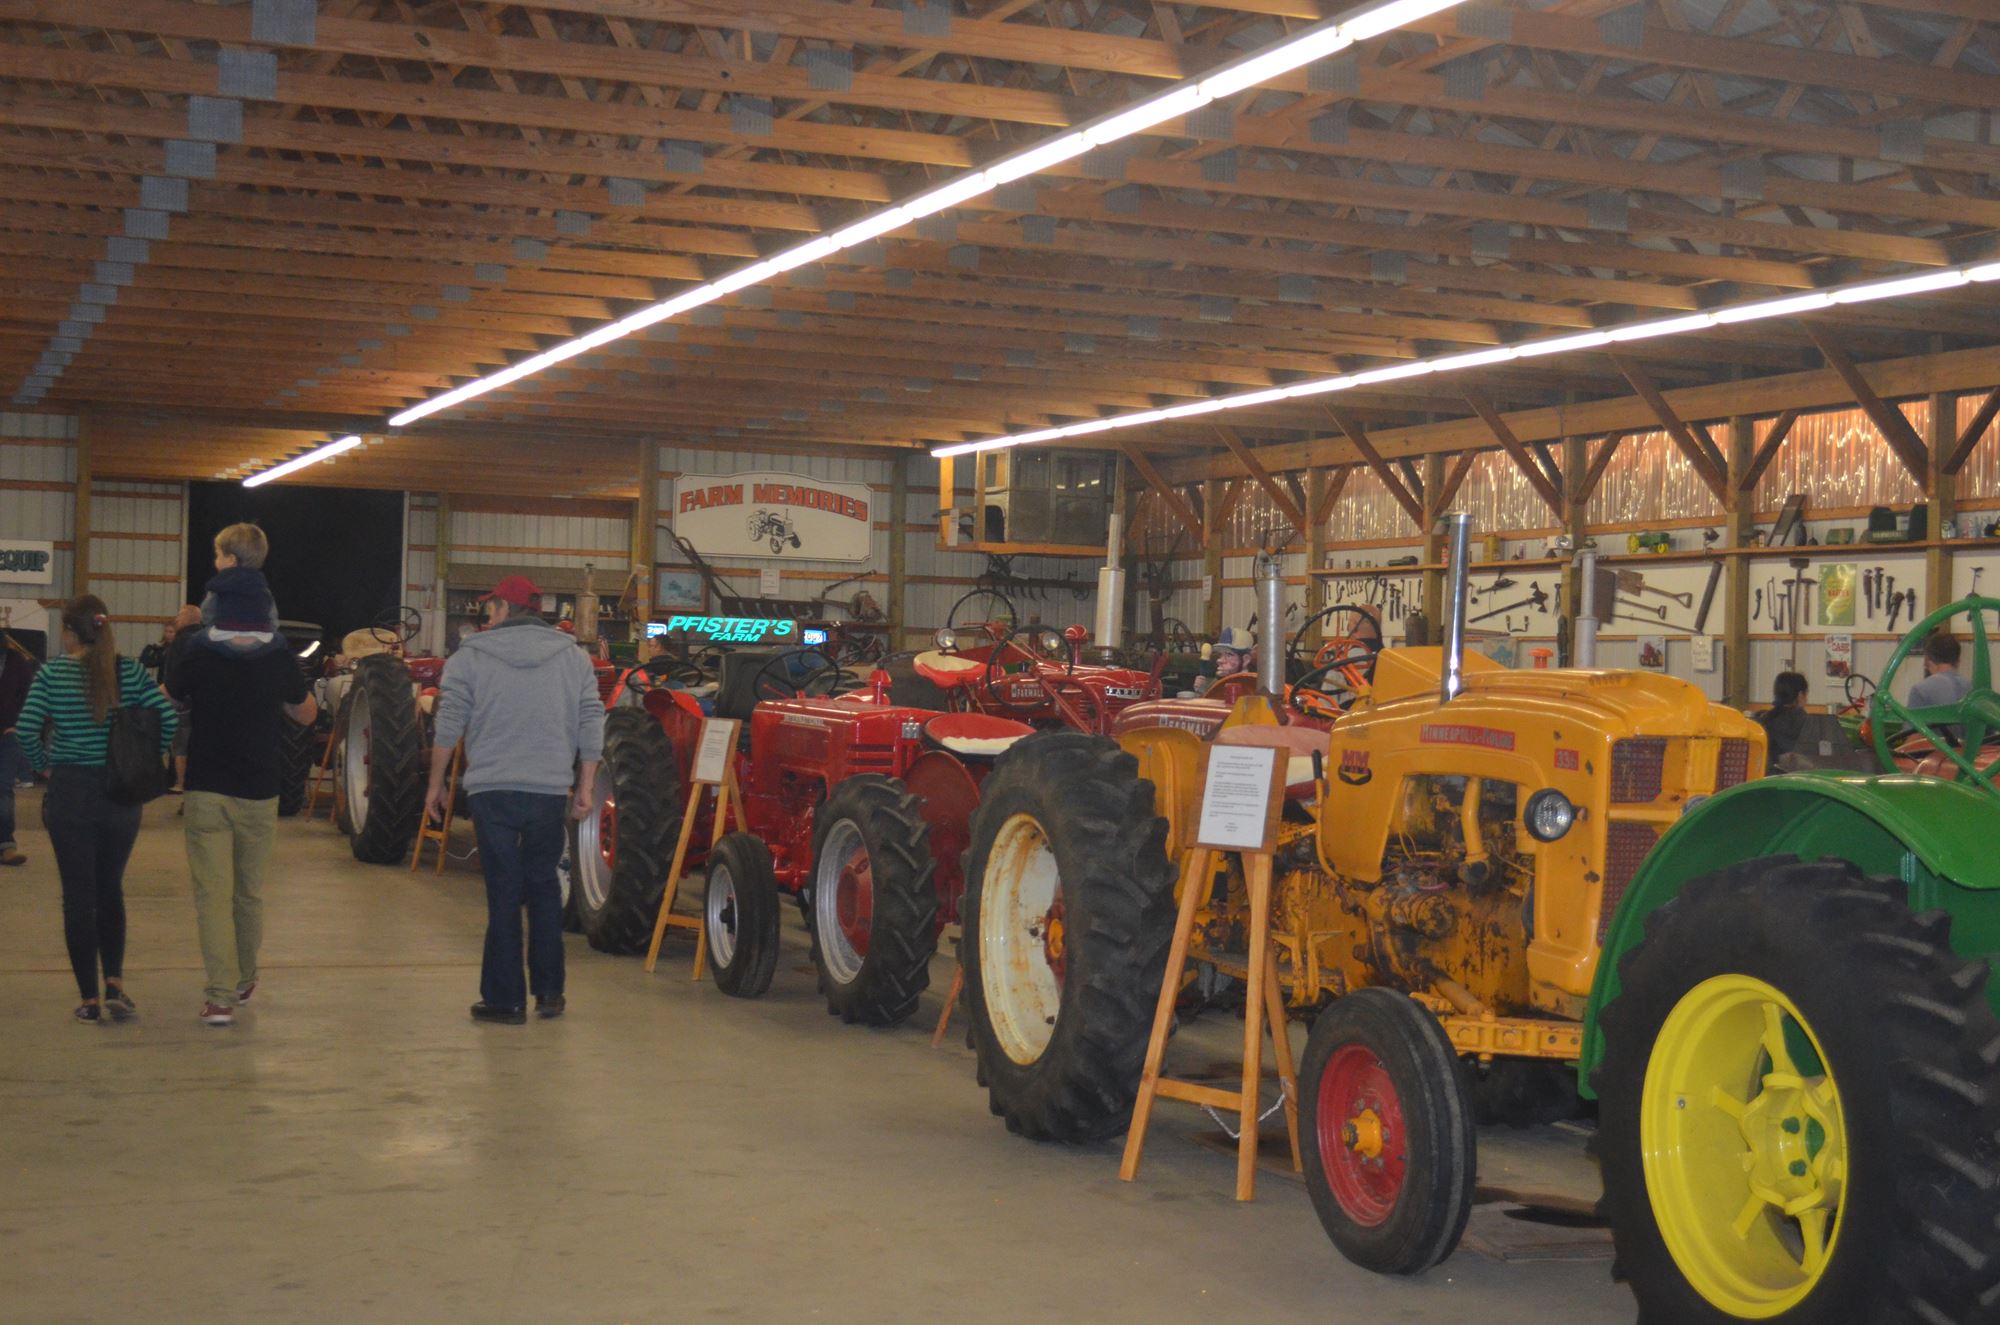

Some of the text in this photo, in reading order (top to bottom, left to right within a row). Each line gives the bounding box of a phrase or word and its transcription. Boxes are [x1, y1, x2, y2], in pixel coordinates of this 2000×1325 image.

[680, 483, 868, 522] FARM MEMORIES
[668, 616, 793, 636] PFISTER'S
[709, 632, 762, 642] FARM
